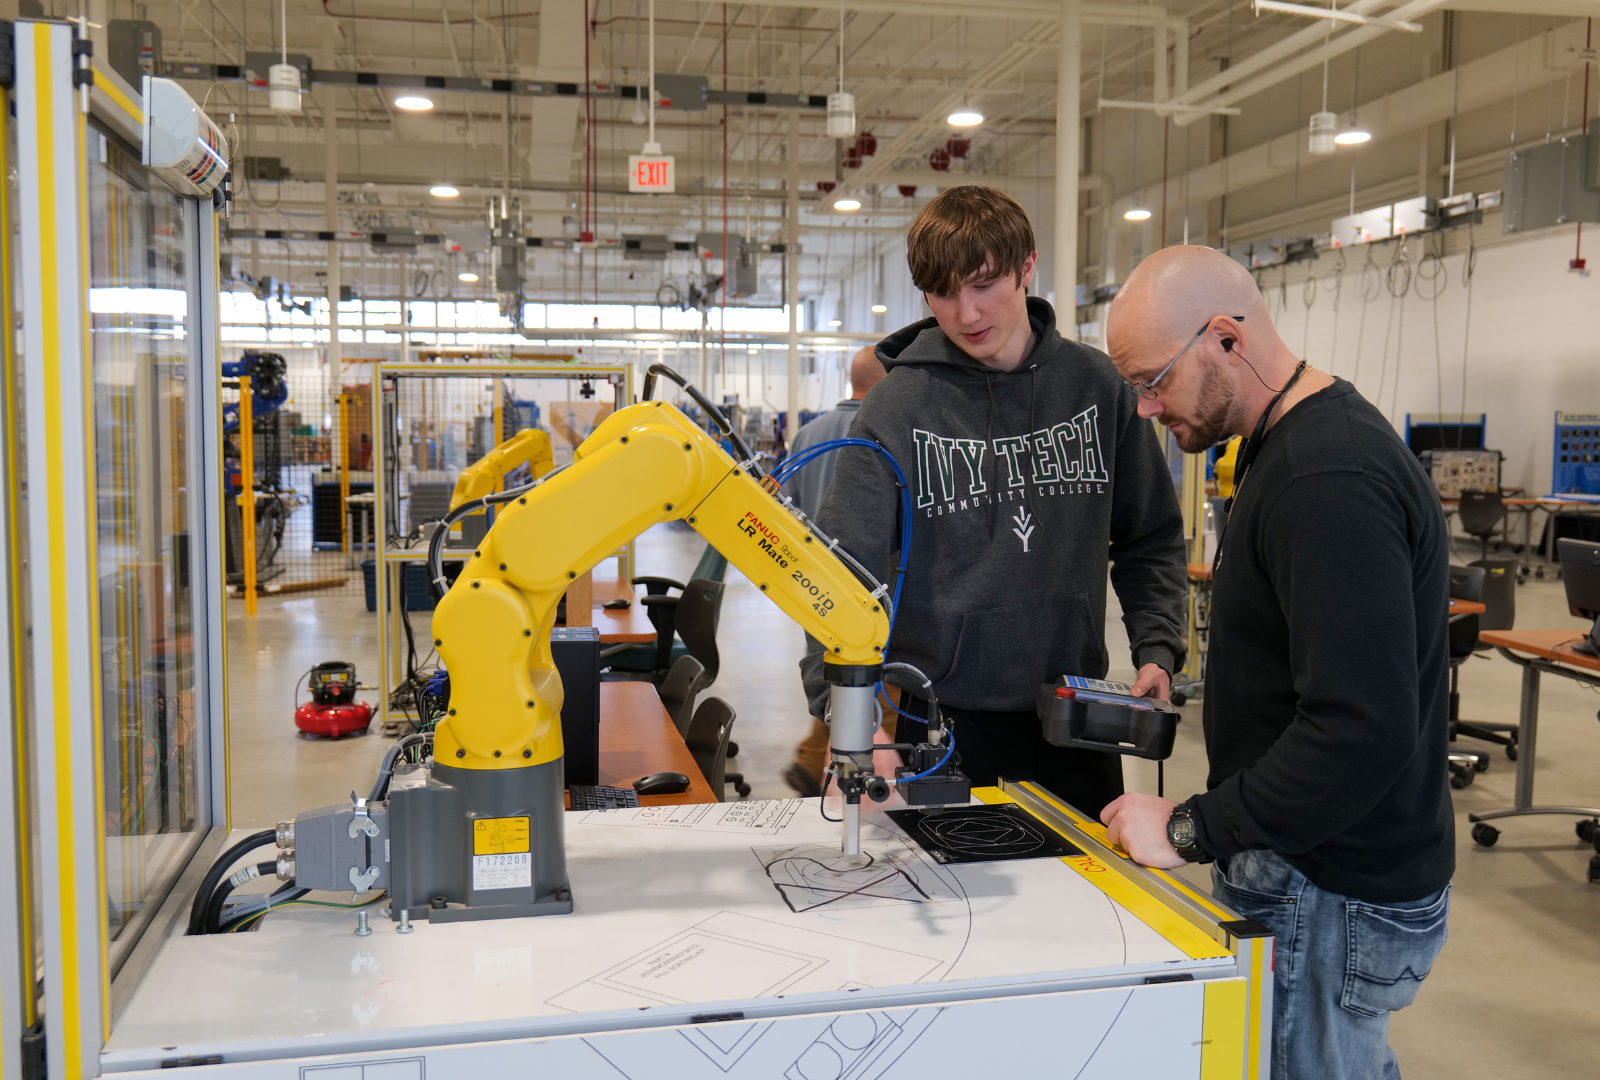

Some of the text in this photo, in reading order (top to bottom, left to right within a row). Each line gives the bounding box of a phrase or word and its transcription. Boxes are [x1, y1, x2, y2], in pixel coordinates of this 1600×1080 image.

[638, 161, 669, 187] EXIT
[913, 404, 1109, 509] IVY TECH
[1039, 484, 1102, 497] COLLEGE
[744, 511, 799, 563] FANUC Robot
[737, 518, 834, 610] LR Mate 200iD
[812, 603, 828, 617] 4S
[478, 854, 527, 866] F172268
